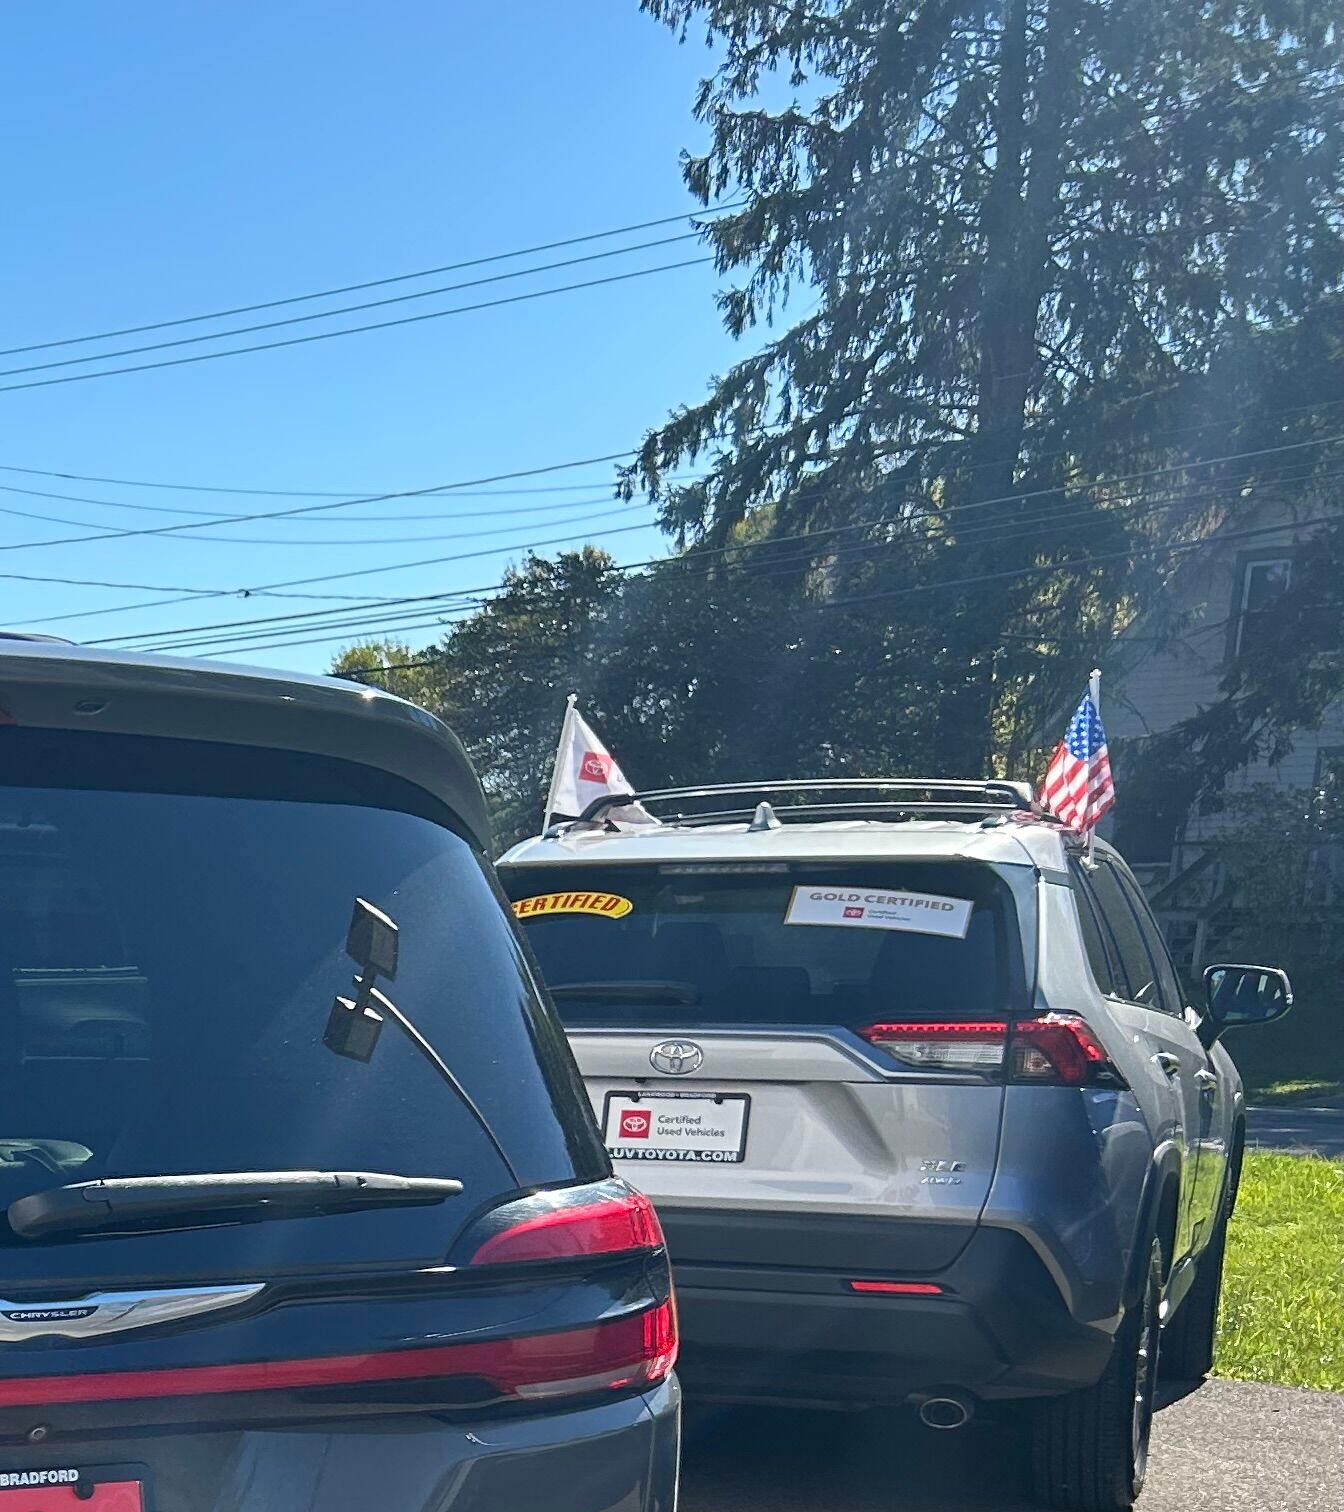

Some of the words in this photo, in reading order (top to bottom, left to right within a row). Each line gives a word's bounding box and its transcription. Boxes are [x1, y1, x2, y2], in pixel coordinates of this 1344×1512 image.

[809, 892, 861, 902] GOLD
[863, 894, 954, 911] CERTIFIED
[657, 1115, 702, 1125] Certified
[657, 1127, 682, 1137] Used
[685, 1128, 726, 1138] Vehicles
[9, 1309, 88, 1320] CHRYSLER
[0, 1469, 80, 1486] BRADFORD
